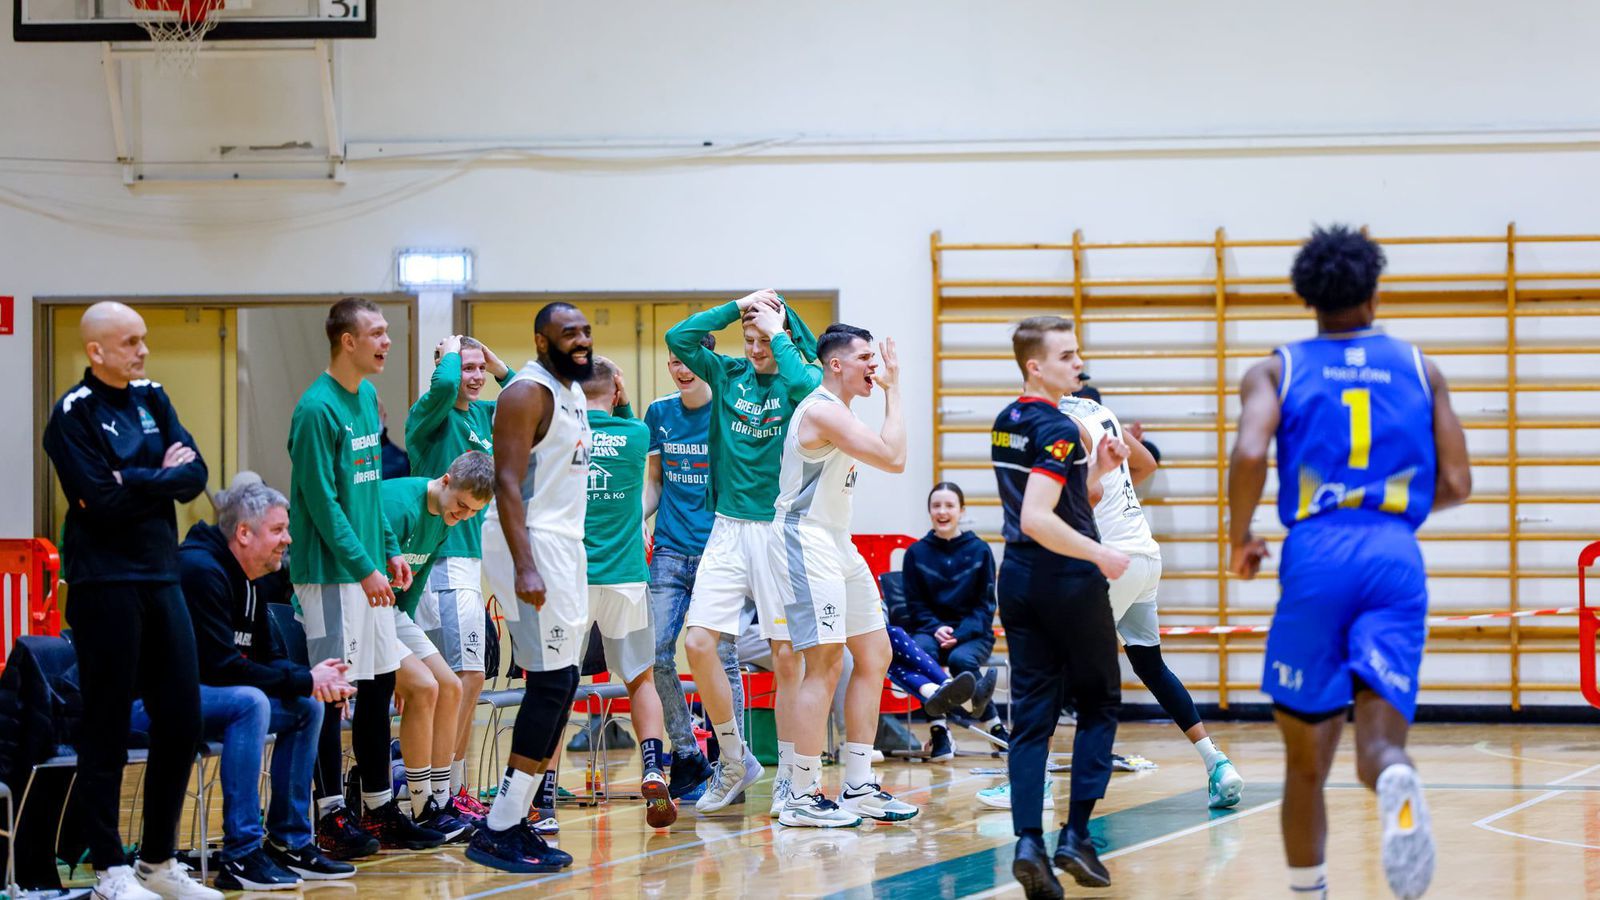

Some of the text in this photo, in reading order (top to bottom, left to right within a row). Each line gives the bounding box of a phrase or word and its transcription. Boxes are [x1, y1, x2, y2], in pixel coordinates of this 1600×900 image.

[734, 397, 781, 415] BREIDLIK
[1341, 387, 1371, 470] 1
[665, 470, 709, 484] ÖRFUBOLT
[603, 492, 611, 500] &
[499, 778, 511, 797] NIKE
